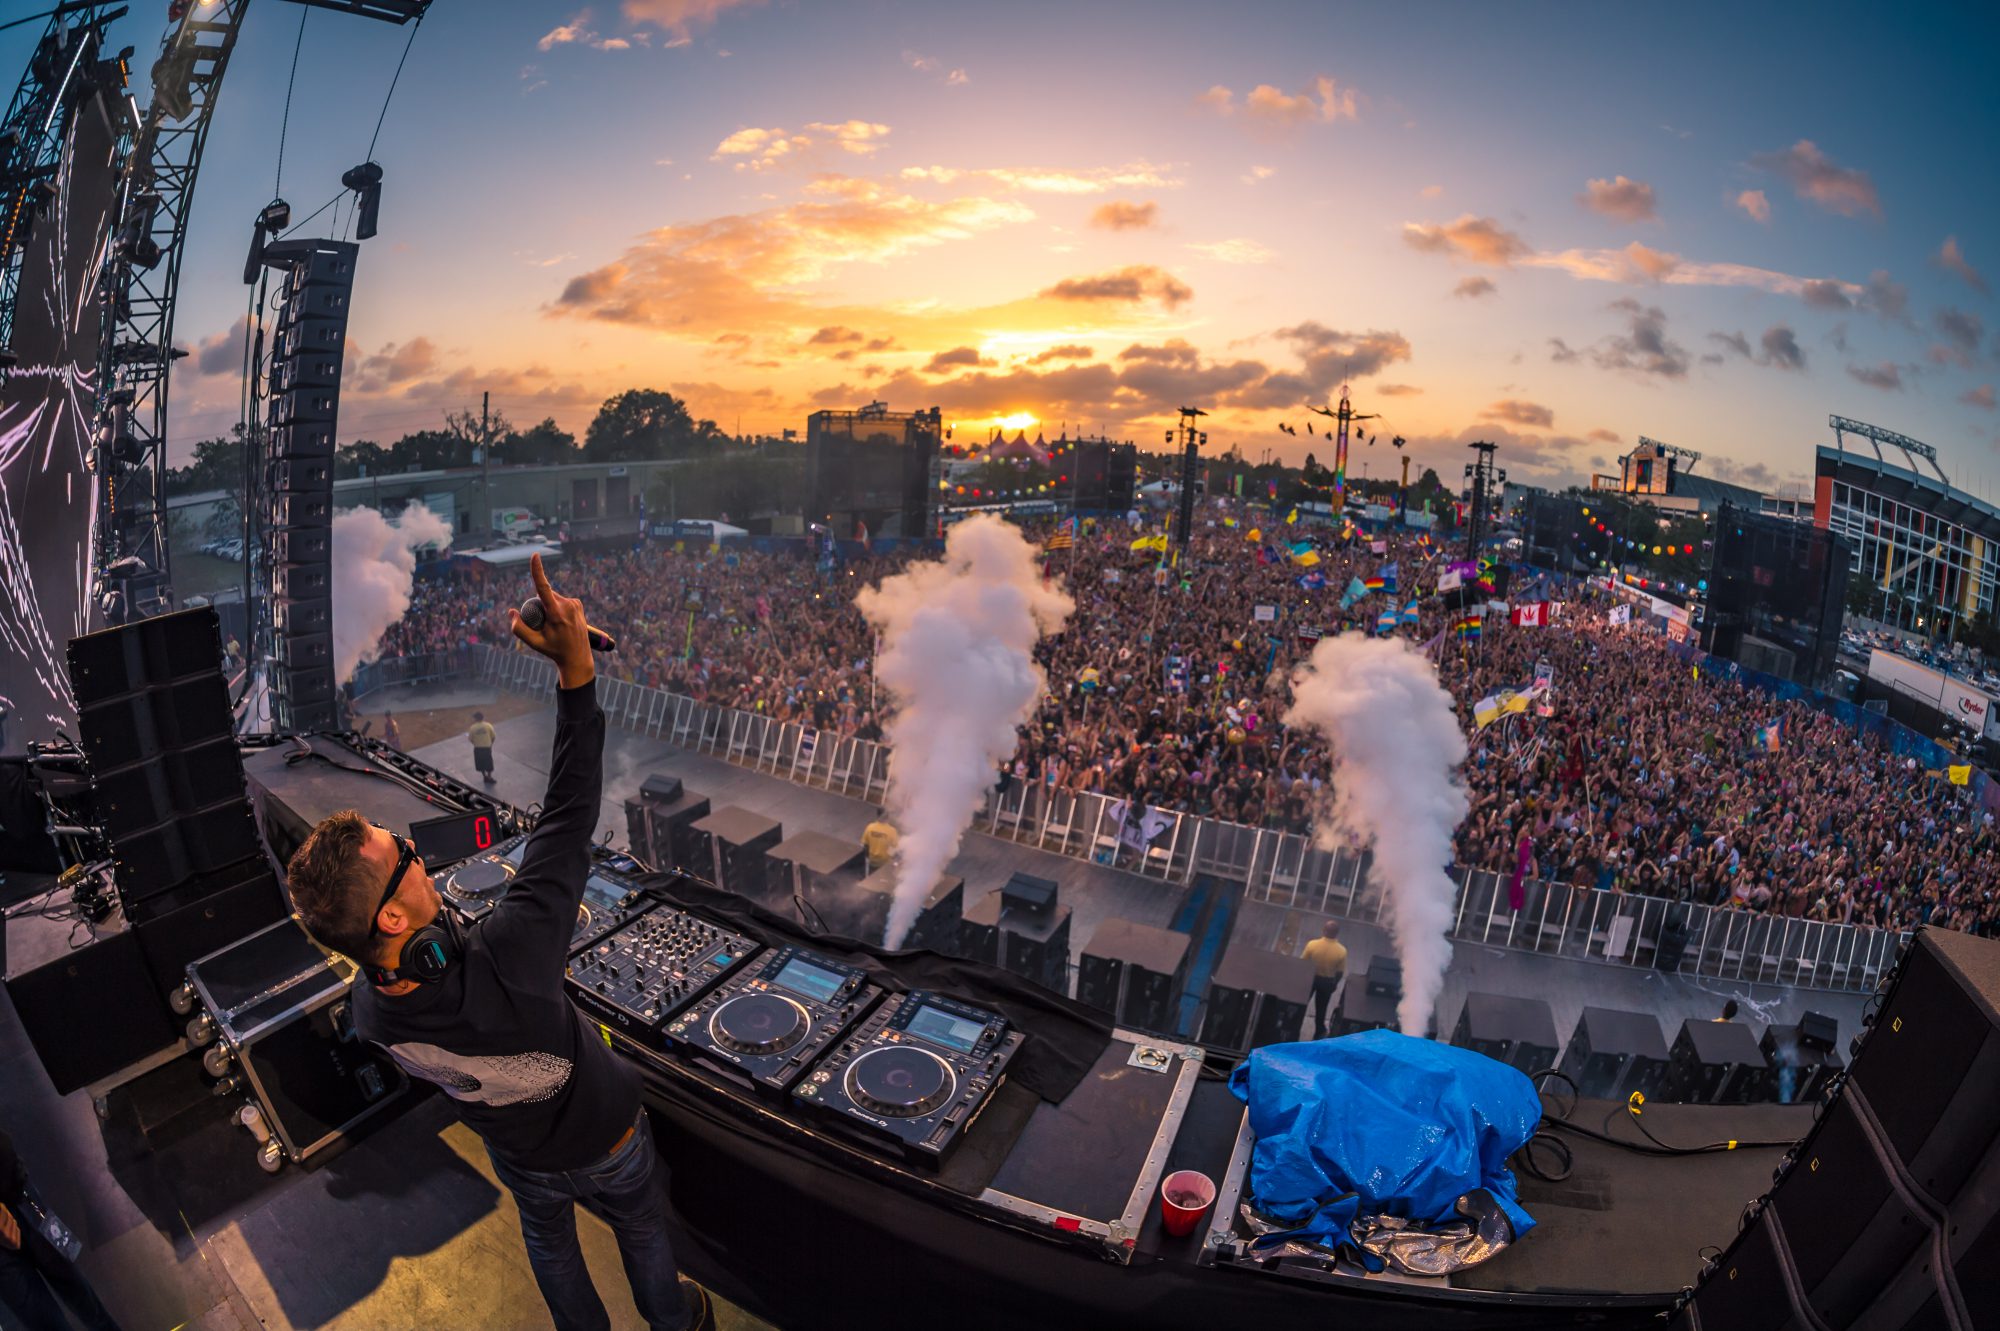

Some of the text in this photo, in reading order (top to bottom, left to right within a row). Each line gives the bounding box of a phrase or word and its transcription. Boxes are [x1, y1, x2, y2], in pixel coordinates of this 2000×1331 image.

[1964, 698, 1984, 715] Ryder
[475, 816, 491, 849] 0
[579, 991, 616, 1016] Pioneer
[848, 1107, 878, 1122] Pioneer
